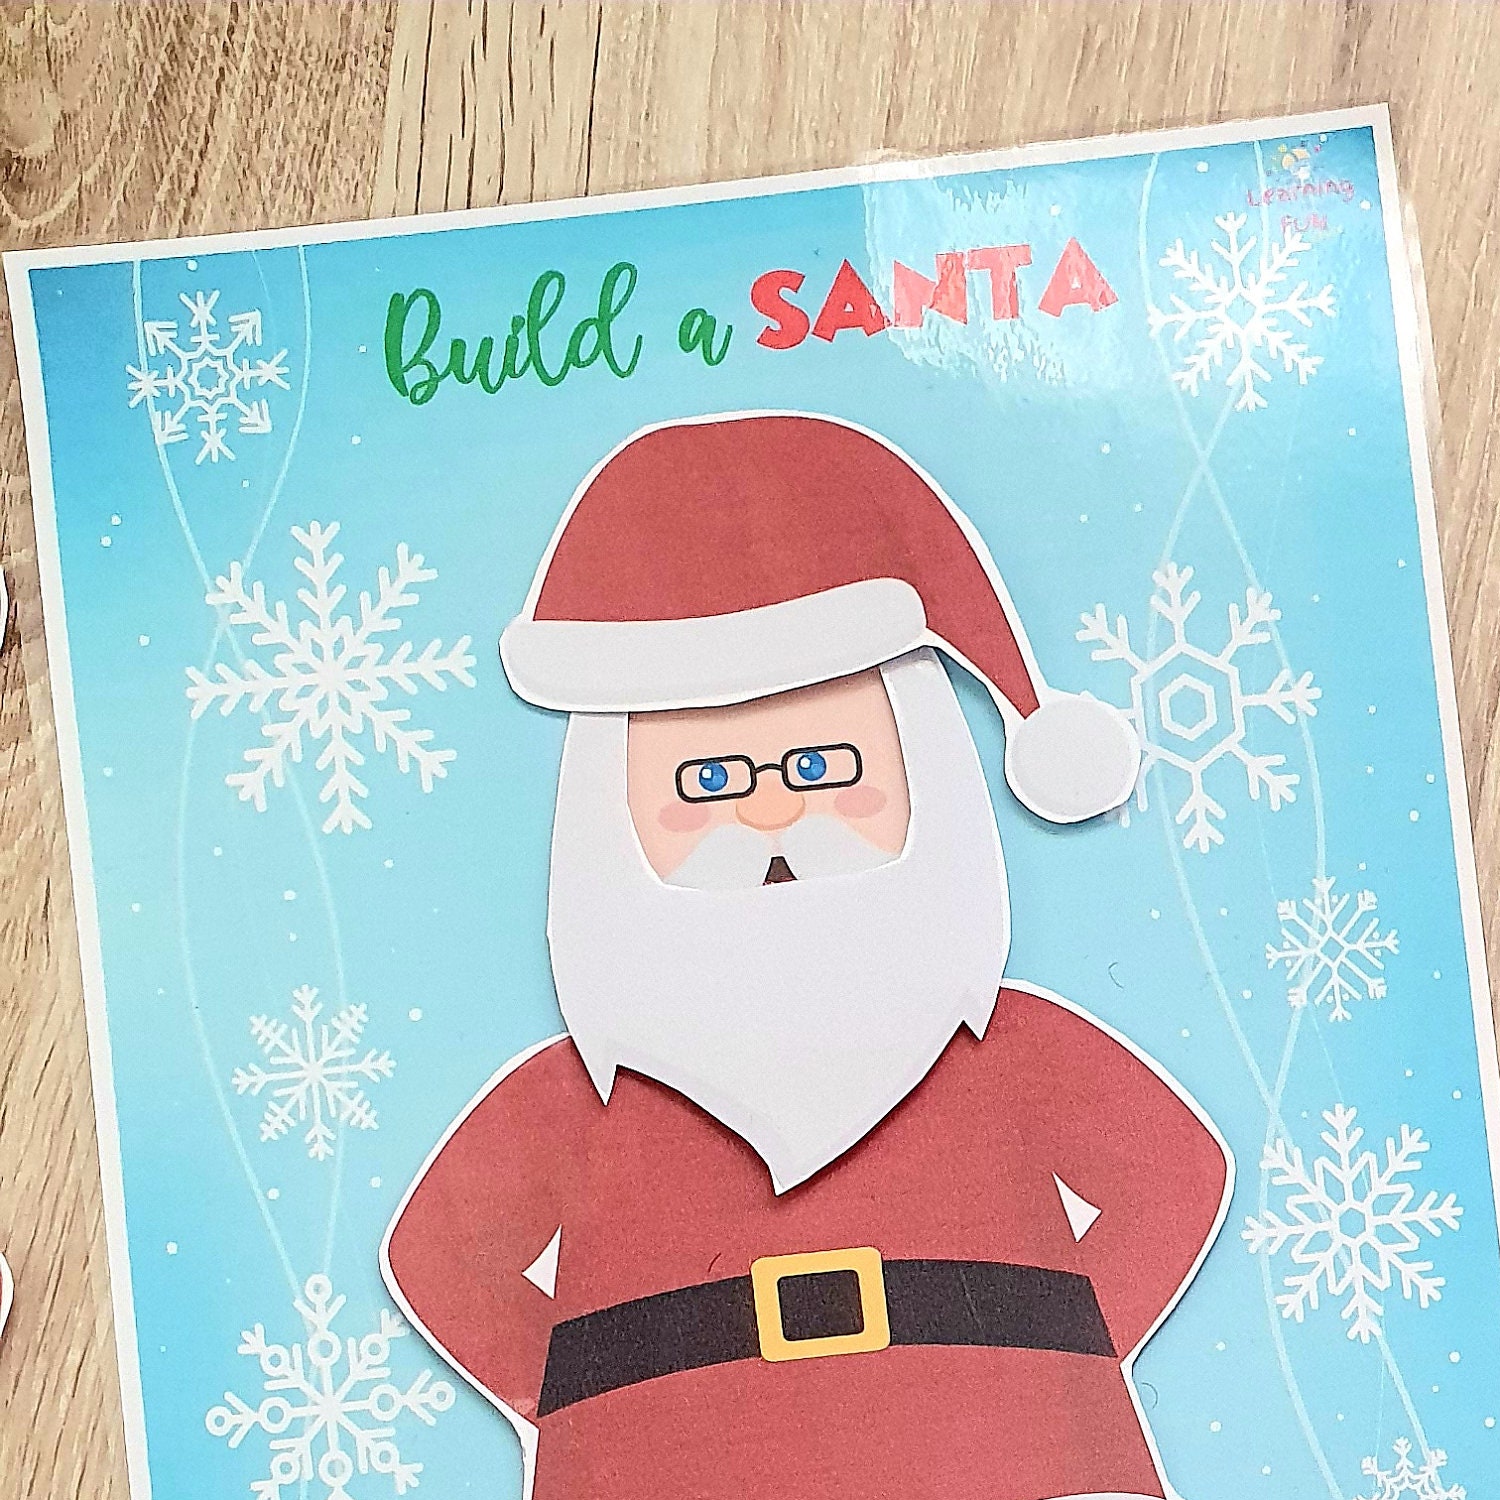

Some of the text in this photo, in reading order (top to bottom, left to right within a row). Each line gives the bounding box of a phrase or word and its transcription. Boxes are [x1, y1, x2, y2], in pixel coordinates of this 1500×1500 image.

[384, 237, 1119, 406] Build a SANTA
